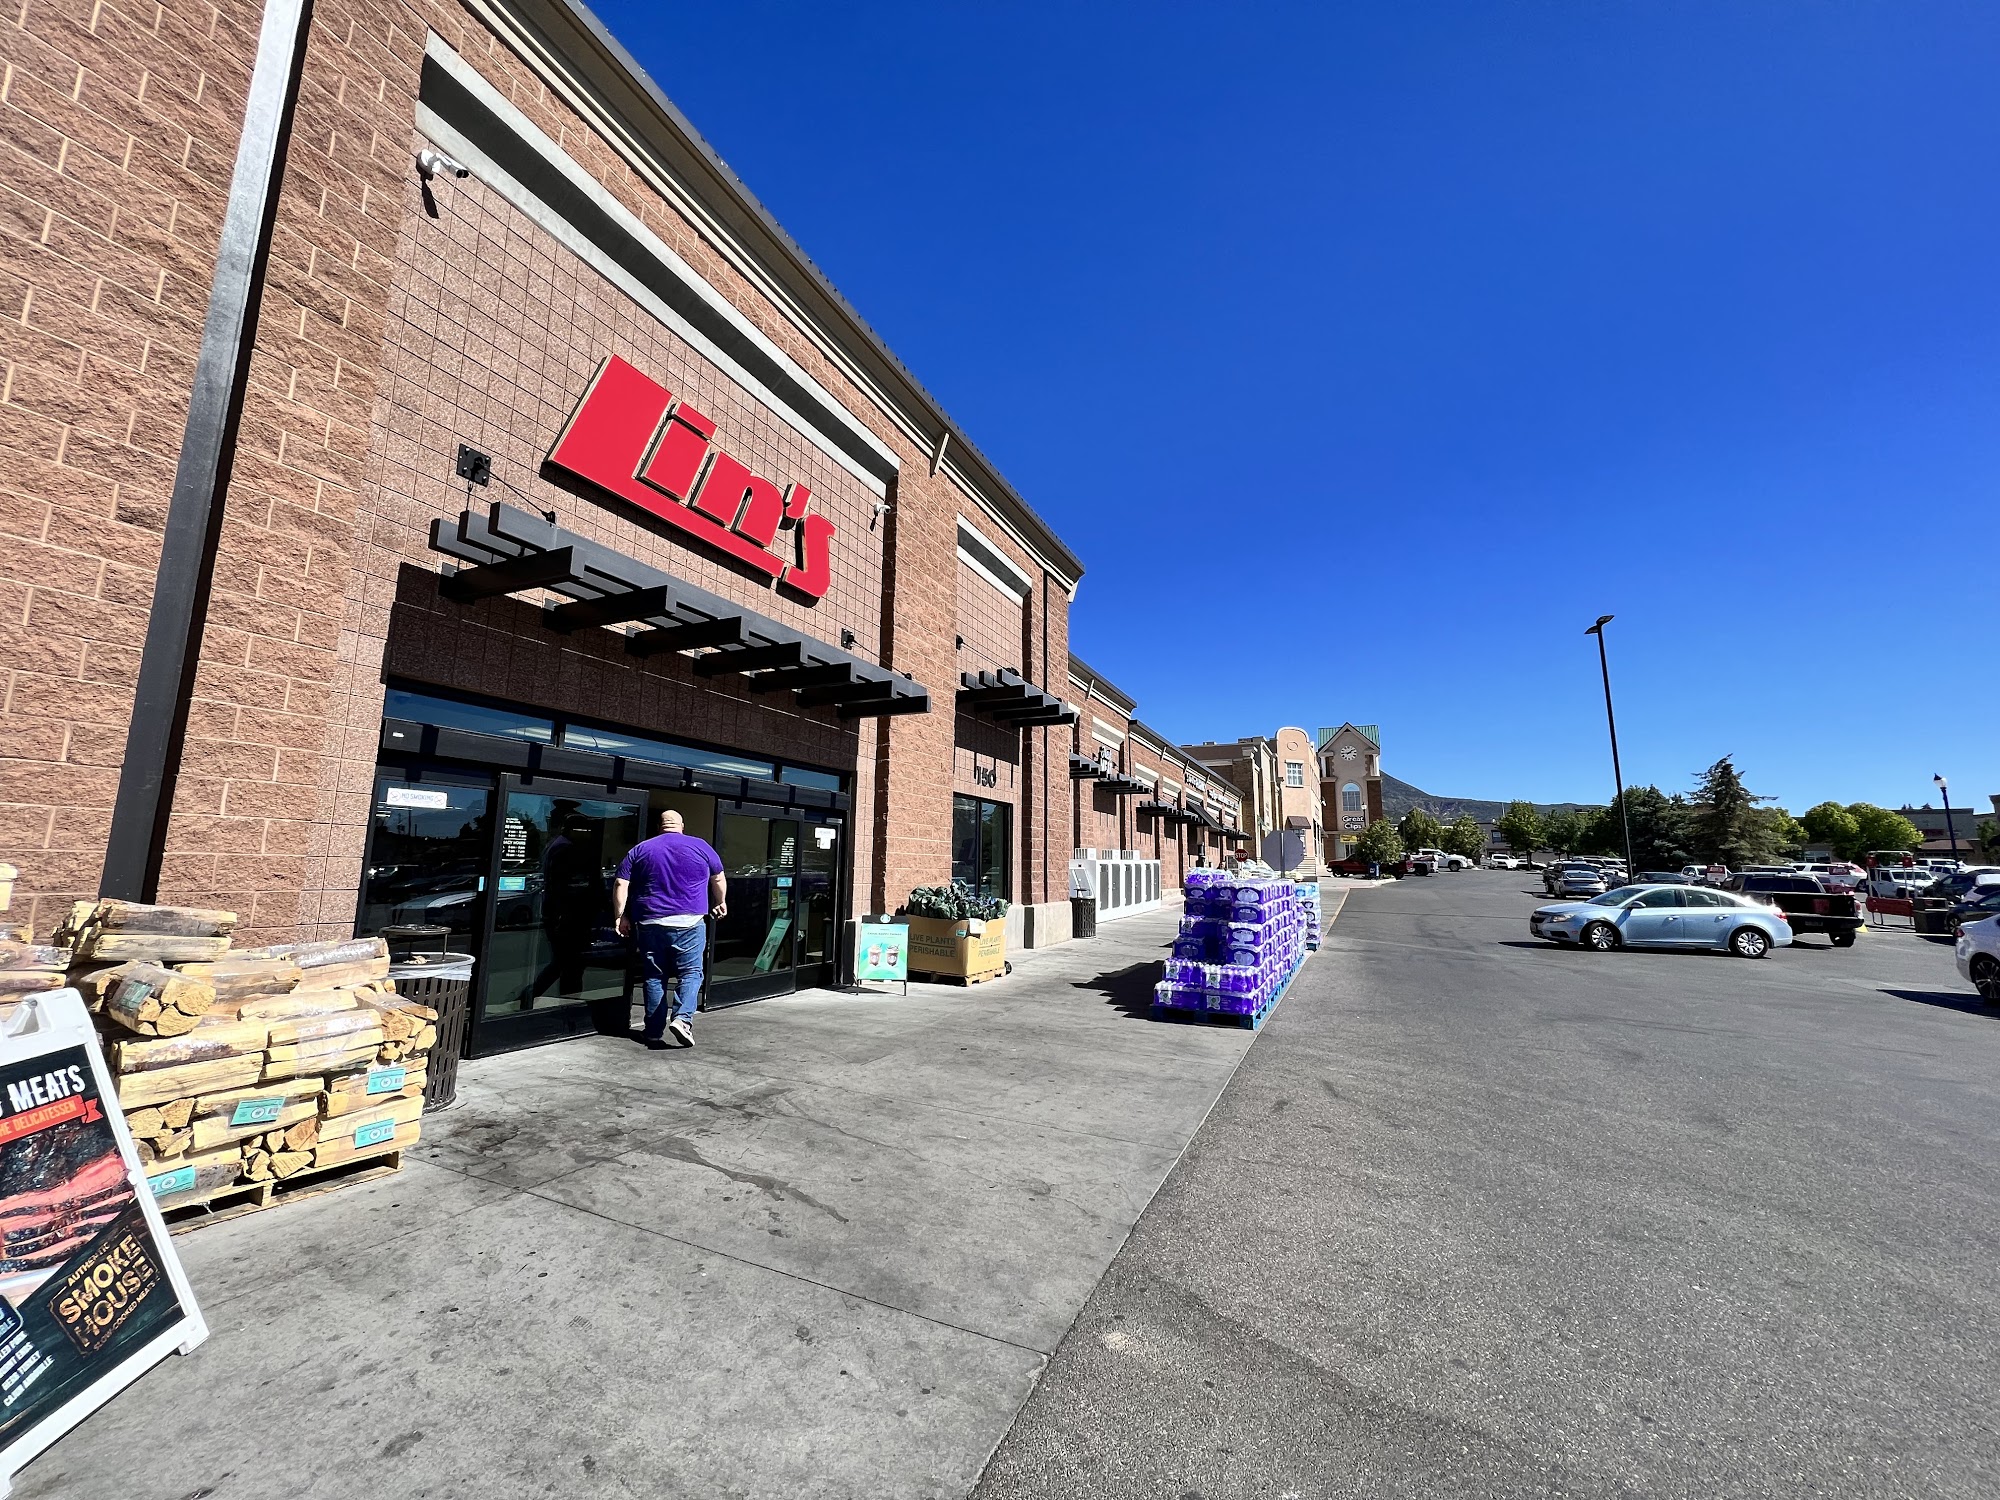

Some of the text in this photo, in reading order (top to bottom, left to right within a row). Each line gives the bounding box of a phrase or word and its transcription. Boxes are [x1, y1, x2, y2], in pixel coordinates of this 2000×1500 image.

[976, 765, 996, 788] 150
[410, 793, 434, 802] SMOKING
[909, 944, 956, 958] PERISHABLE
[910, 933, 956, 946] LIVE PLANTS
[7, 1064, 86, 1113] MEATS
[0, 1121, 12, 1137] HE
[12, 1100, 77, 1132] DELICATESSEN
[59, 1234, 141, 1324] SMOKE
[67, 1242, 111, 1287] AUTHENTIC
[74, 1256, 155, 1347] HOUSE
